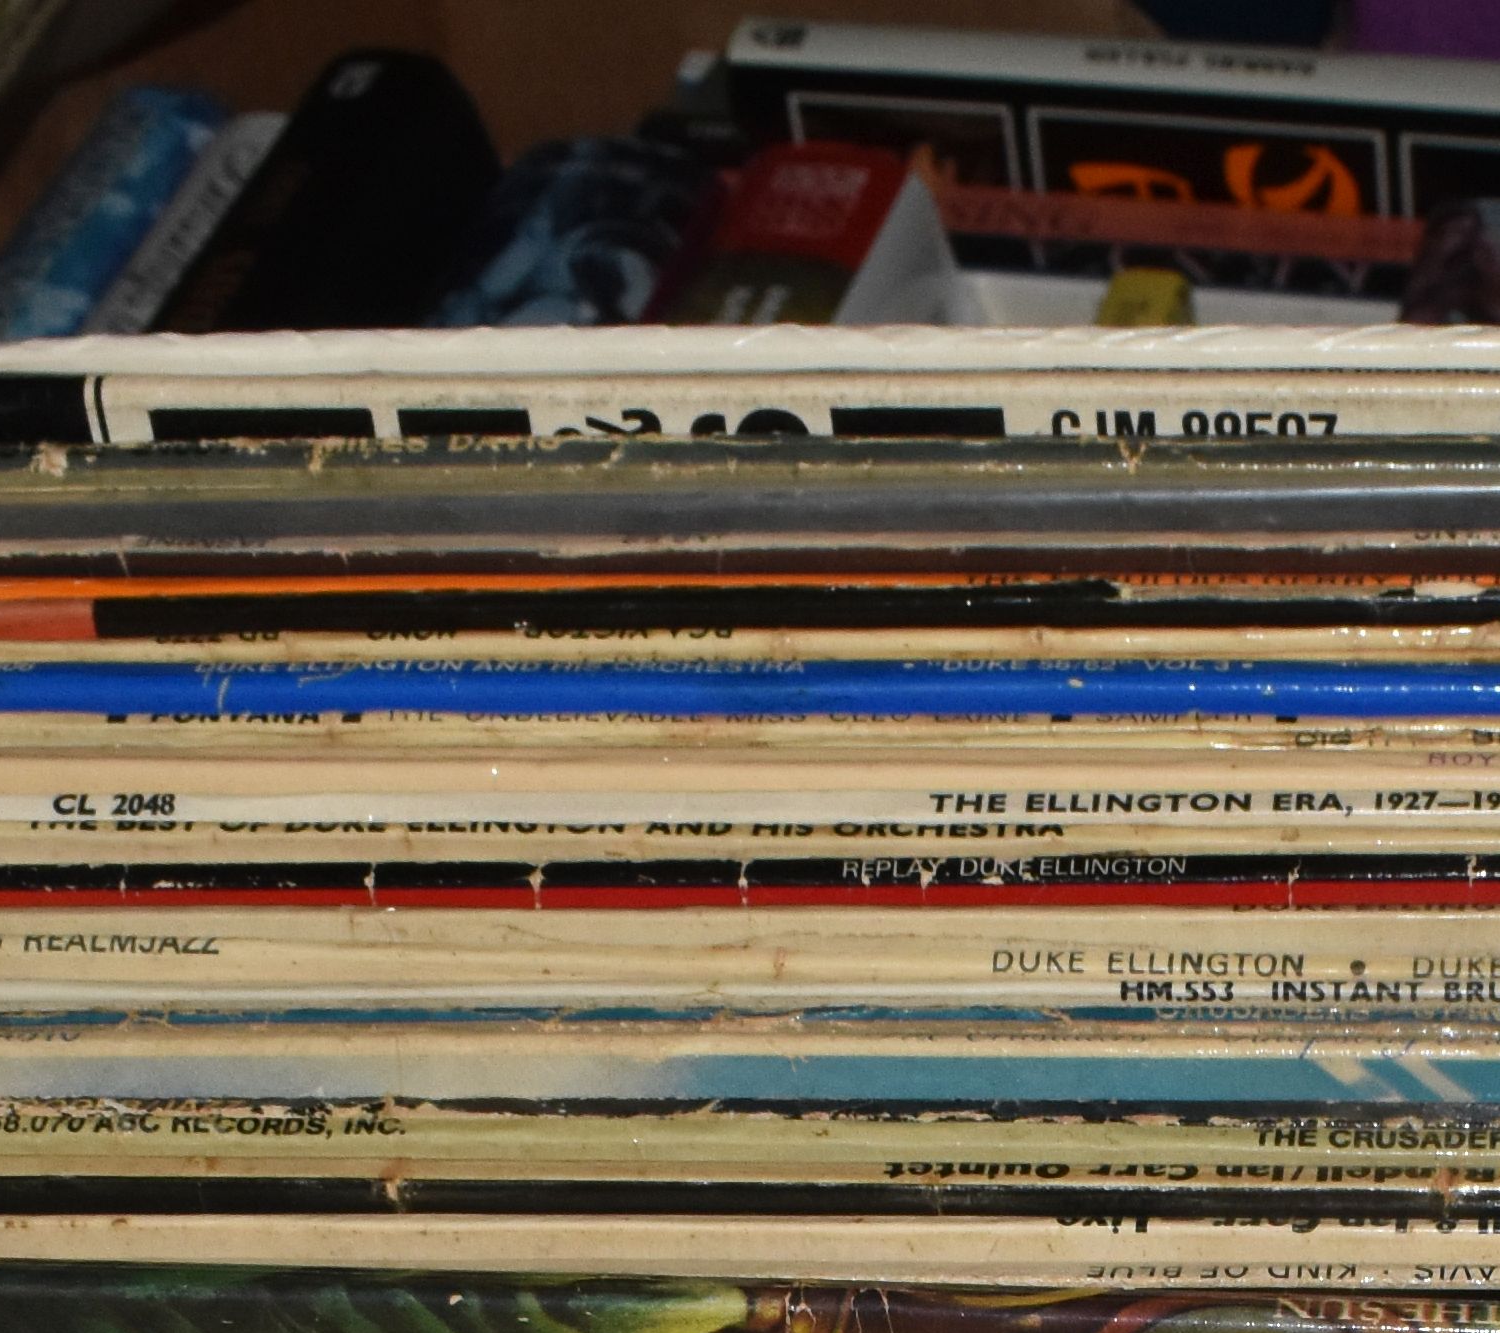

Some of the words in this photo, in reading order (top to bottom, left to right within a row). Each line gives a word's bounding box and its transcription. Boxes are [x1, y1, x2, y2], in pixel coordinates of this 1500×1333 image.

[605, 660, 807, 675] ORCHESTRA
[1143, 659, 1206, 672] VOL
[52, 794, 96, 816] CL
[112, 793, 176, 817] 2048
[929, 794, 1012, 813] THE
[1025, 793, 1259, 814] ELLINGTON
[1272, 793, 1353, 819] ERA,
[832, 822, 1065, 840] ORCHESTRA
[959, 857, 1035, 880] DUKE
[1038, 856, 1188, 878] ELLINGTON
[993, 950, 1086, 976] DUKE
[1107, 951, 1305, 977] ELLINGTON
[1119, 980, 1236, 1004] HM.553
[1272, 980, 1423, 1004] INSTANT
[343, 1115, 407, 1136] INC.
[1255, 1128, 1317, 1149] THE
